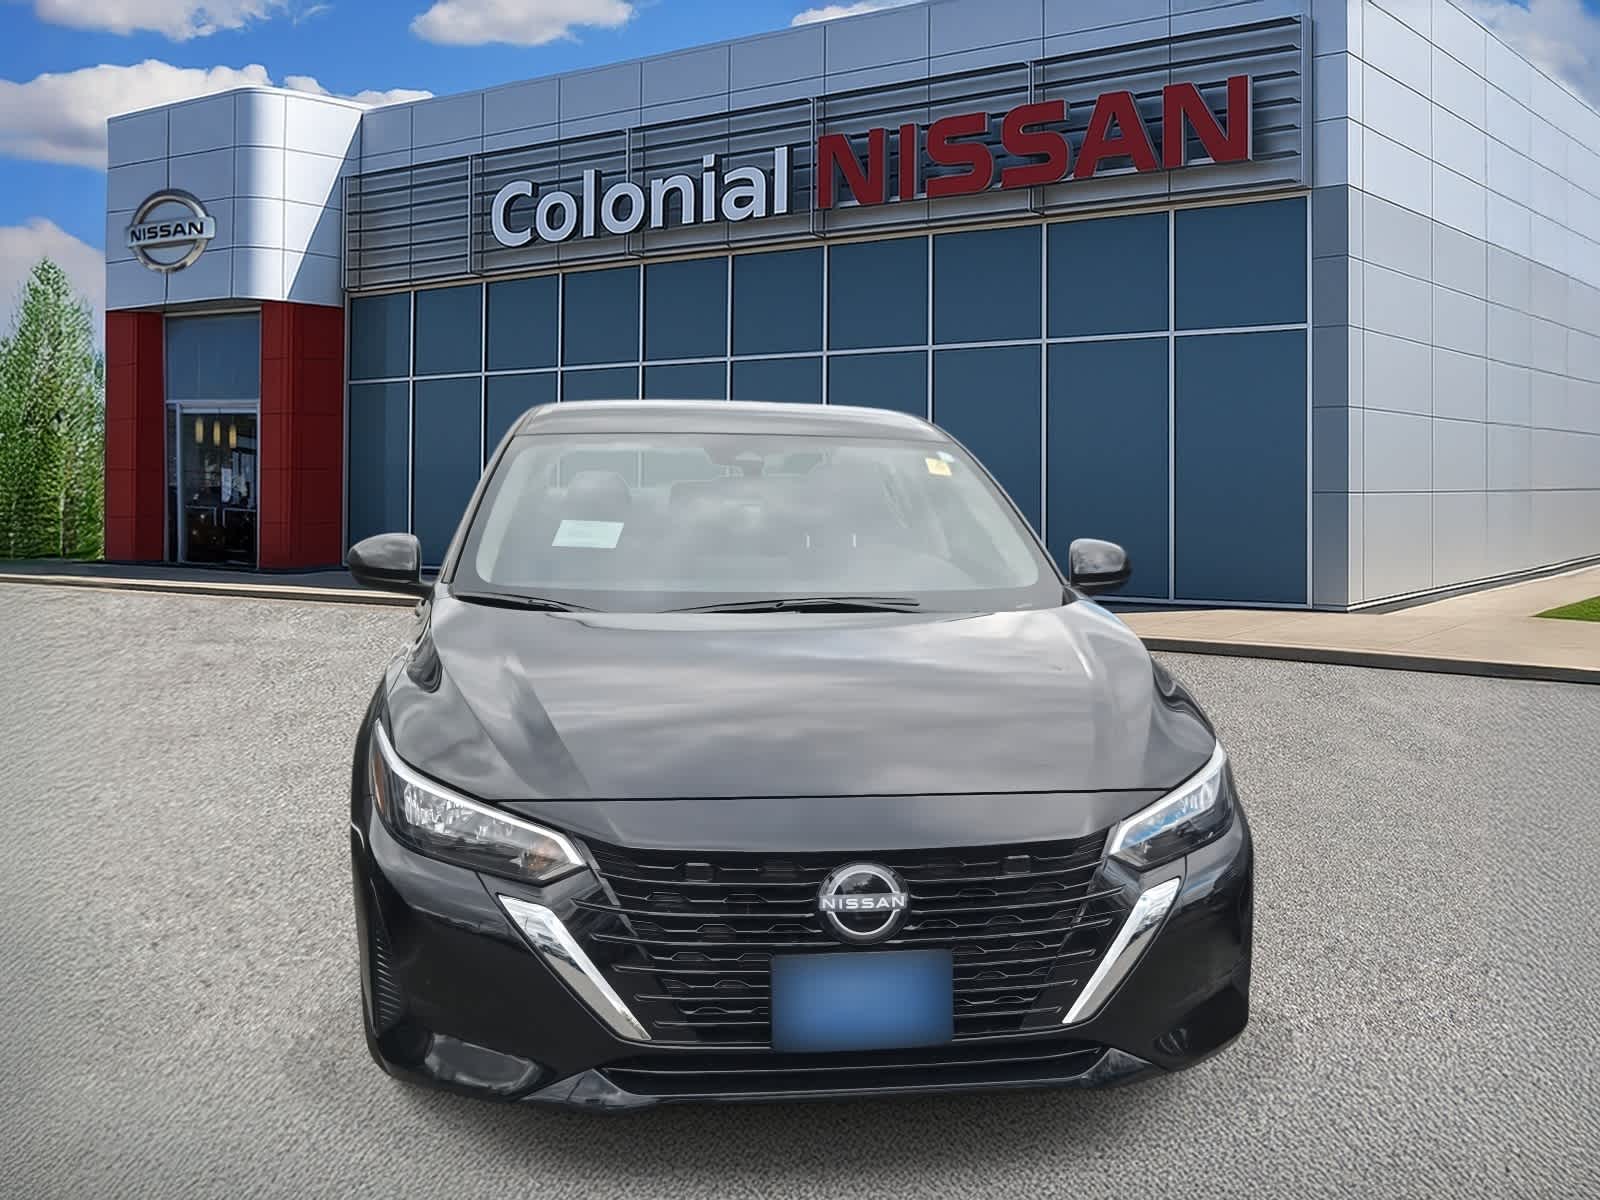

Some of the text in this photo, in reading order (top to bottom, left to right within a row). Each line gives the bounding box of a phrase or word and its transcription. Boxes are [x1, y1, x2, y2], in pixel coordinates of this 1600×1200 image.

[490, 75, 1253, 248] Colonial NISSAN
[130, 221, 204, 242] NISSAN
[822, 895, 905, 909] NISSAN
